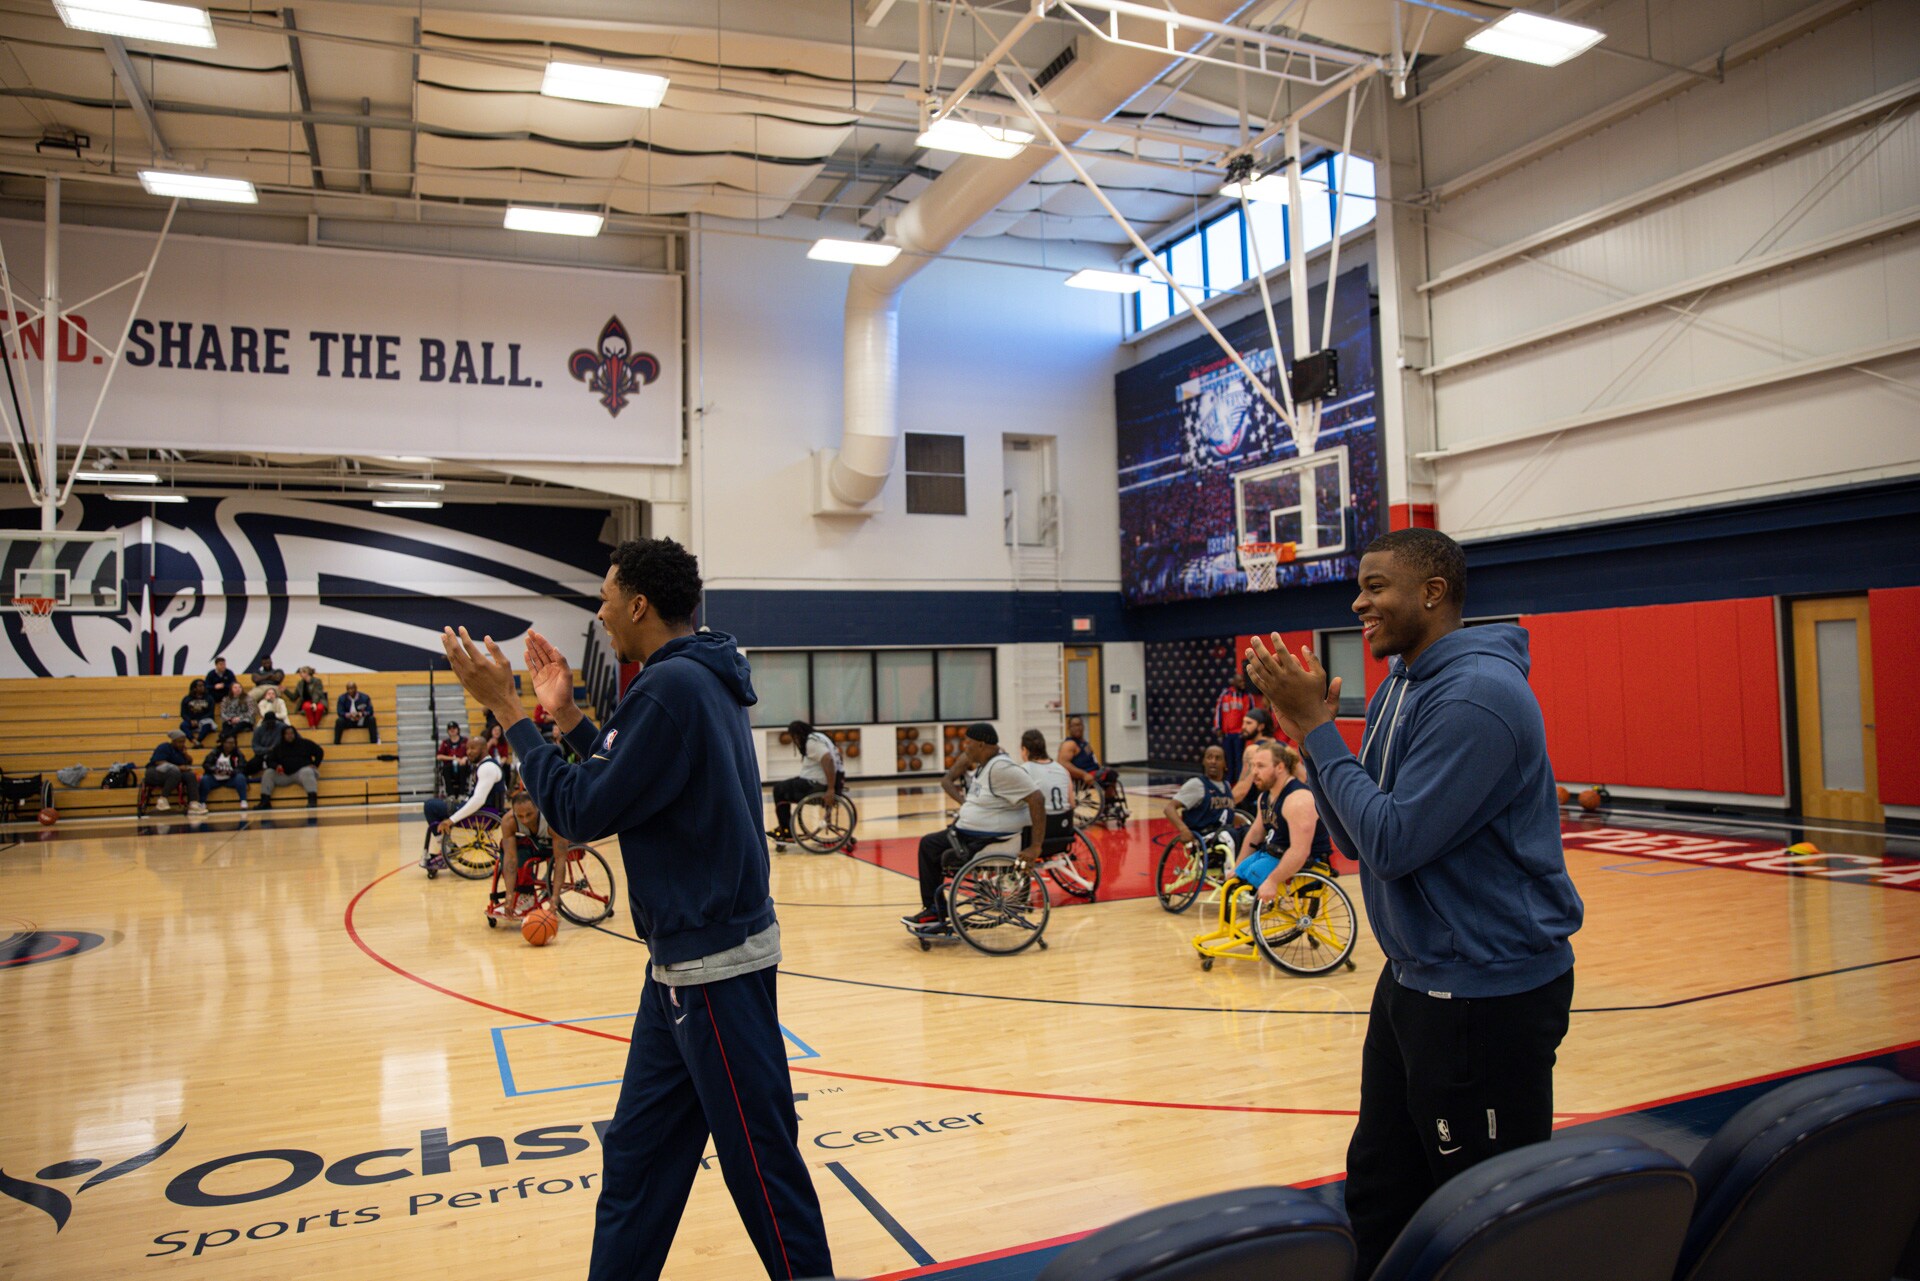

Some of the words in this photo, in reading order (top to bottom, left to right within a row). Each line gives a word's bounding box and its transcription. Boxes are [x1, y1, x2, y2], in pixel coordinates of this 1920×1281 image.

[126, 318, 290, 375] SHARE
[310, 331, 401, 380] THE
[419, 338, 544, 388] BALL.
[1051, 787, 1063, 810] 0
[145, 1202, 381, 1257] Sports
[409, 1155, 718, 1216] Perfor
[814, 1112, 986, 1149] Center
[165, 1092, 809, 1207] Ochs
[815, 1087, 844, 1095] TM
